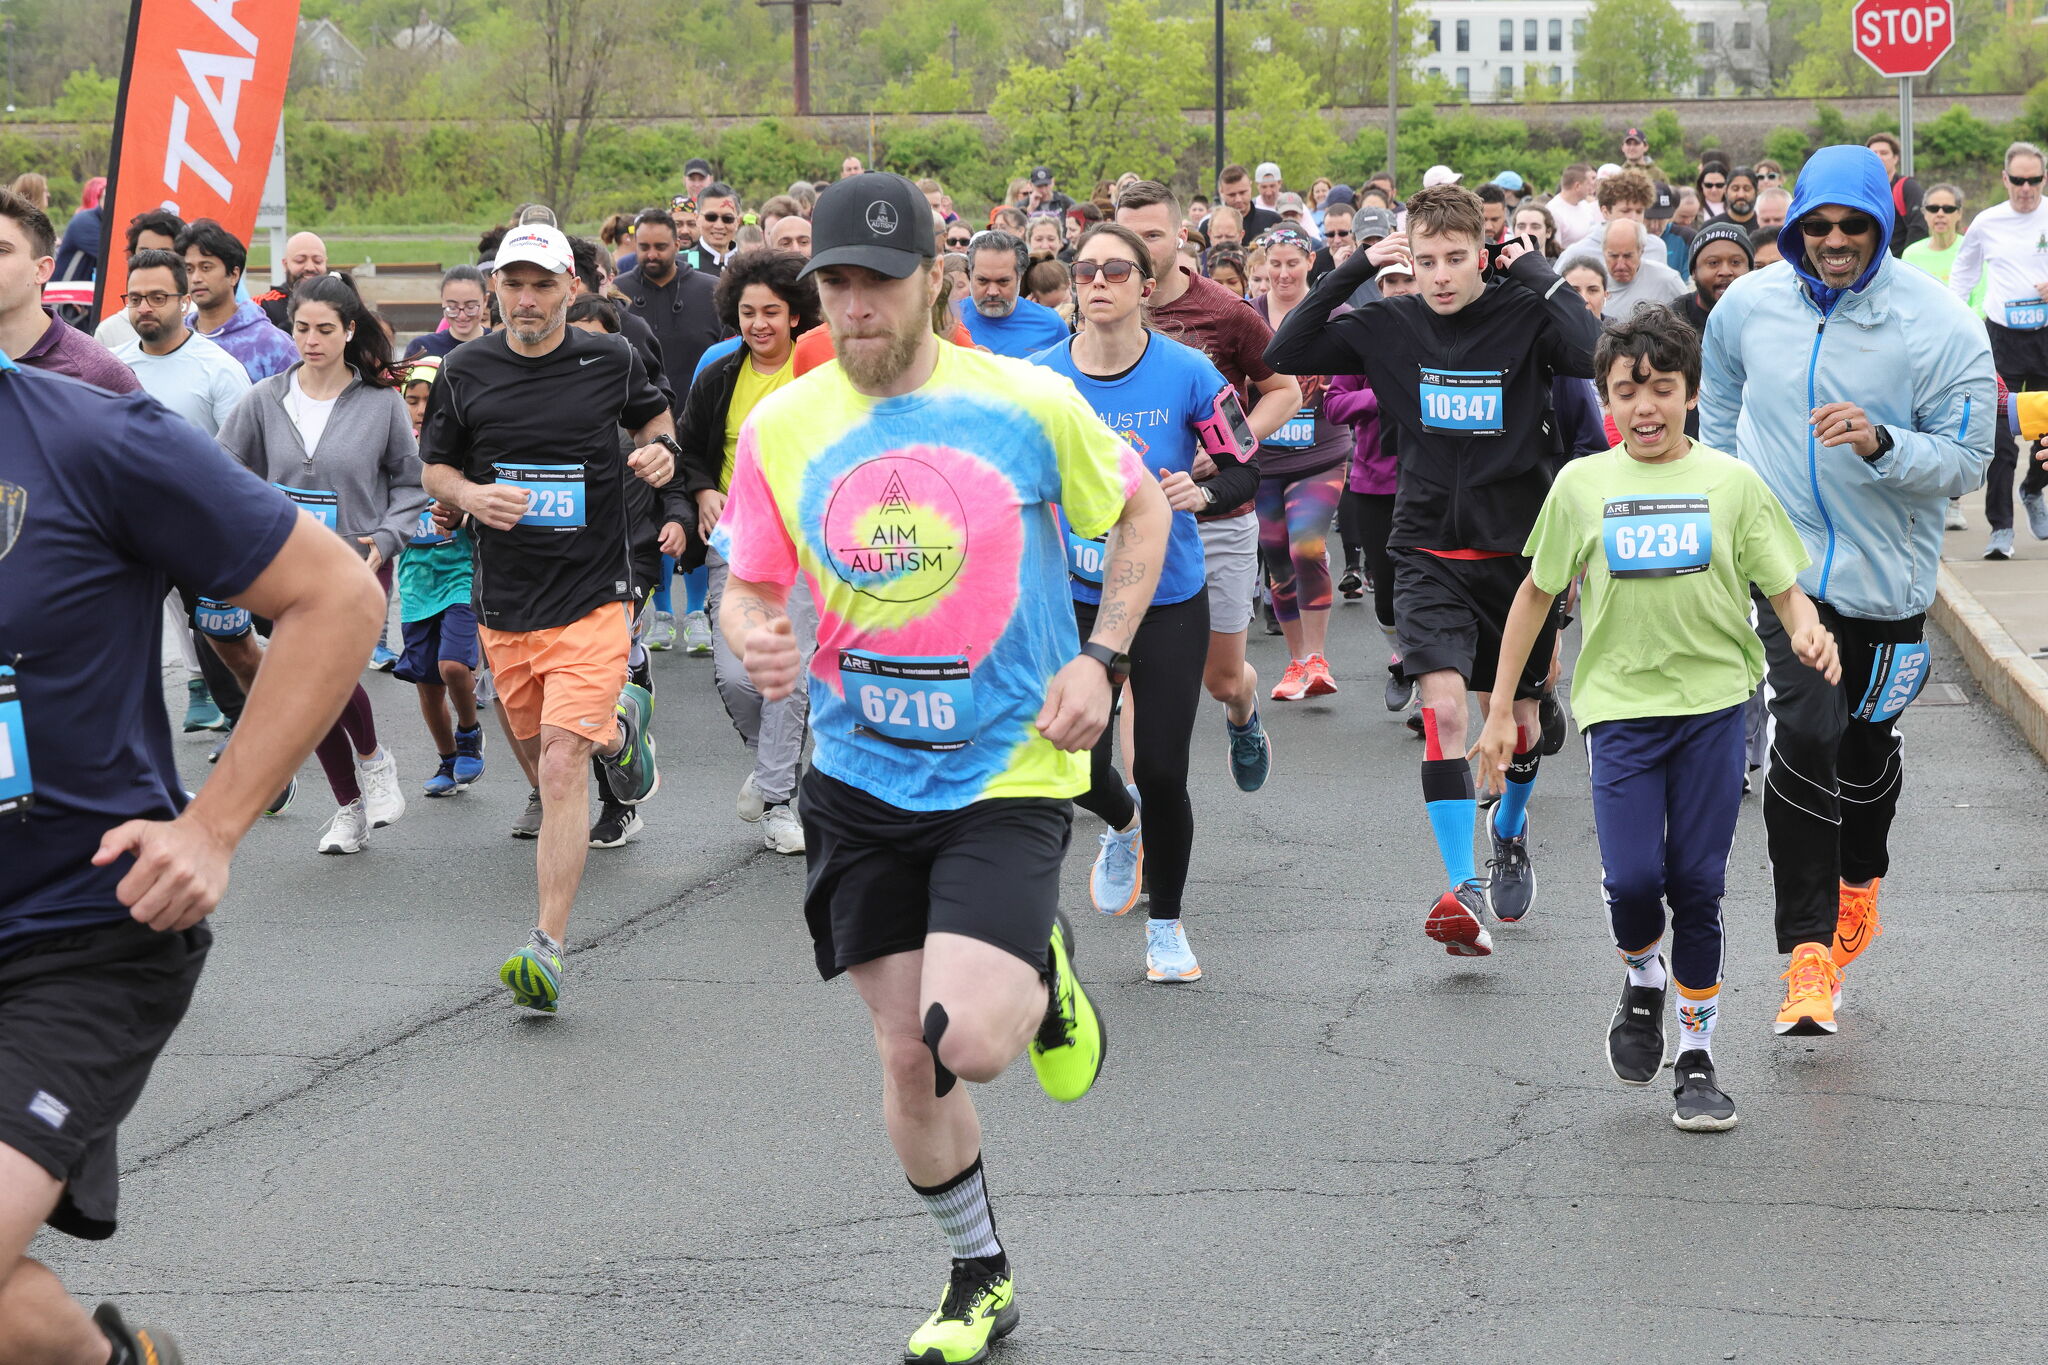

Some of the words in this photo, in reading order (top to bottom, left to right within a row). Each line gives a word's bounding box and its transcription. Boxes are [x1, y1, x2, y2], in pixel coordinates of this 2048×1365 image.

[1861, 6, 1946, 47] STOP
[160, 0, 259, 218] TA
[871, 220, 894, 229] AUTISM
[2010, 308, 2045, 325] 6236
[1423, 374, 1440, 382] ARE
[1425, 393, 1497, 421] 10347
[499, 470, 518, 478] ARE
[523, 490, 574, 517] 225
[1606, 503, 1630, 514] ARE
[871, 524, 916, 545] AIM
[1616, 523, 1699, 560] 6234
[851, 552, 942, 573] AUTISM
[843, 656, 871, 670] ARE
[882, 665, 899, 674] Timing
[943, 667, 969, 675] Logistics
[1882, 652, 1925, 713] 6235
[860, 684, 956, 731] 6216
[1862, 702, 1875, 719] ARE
